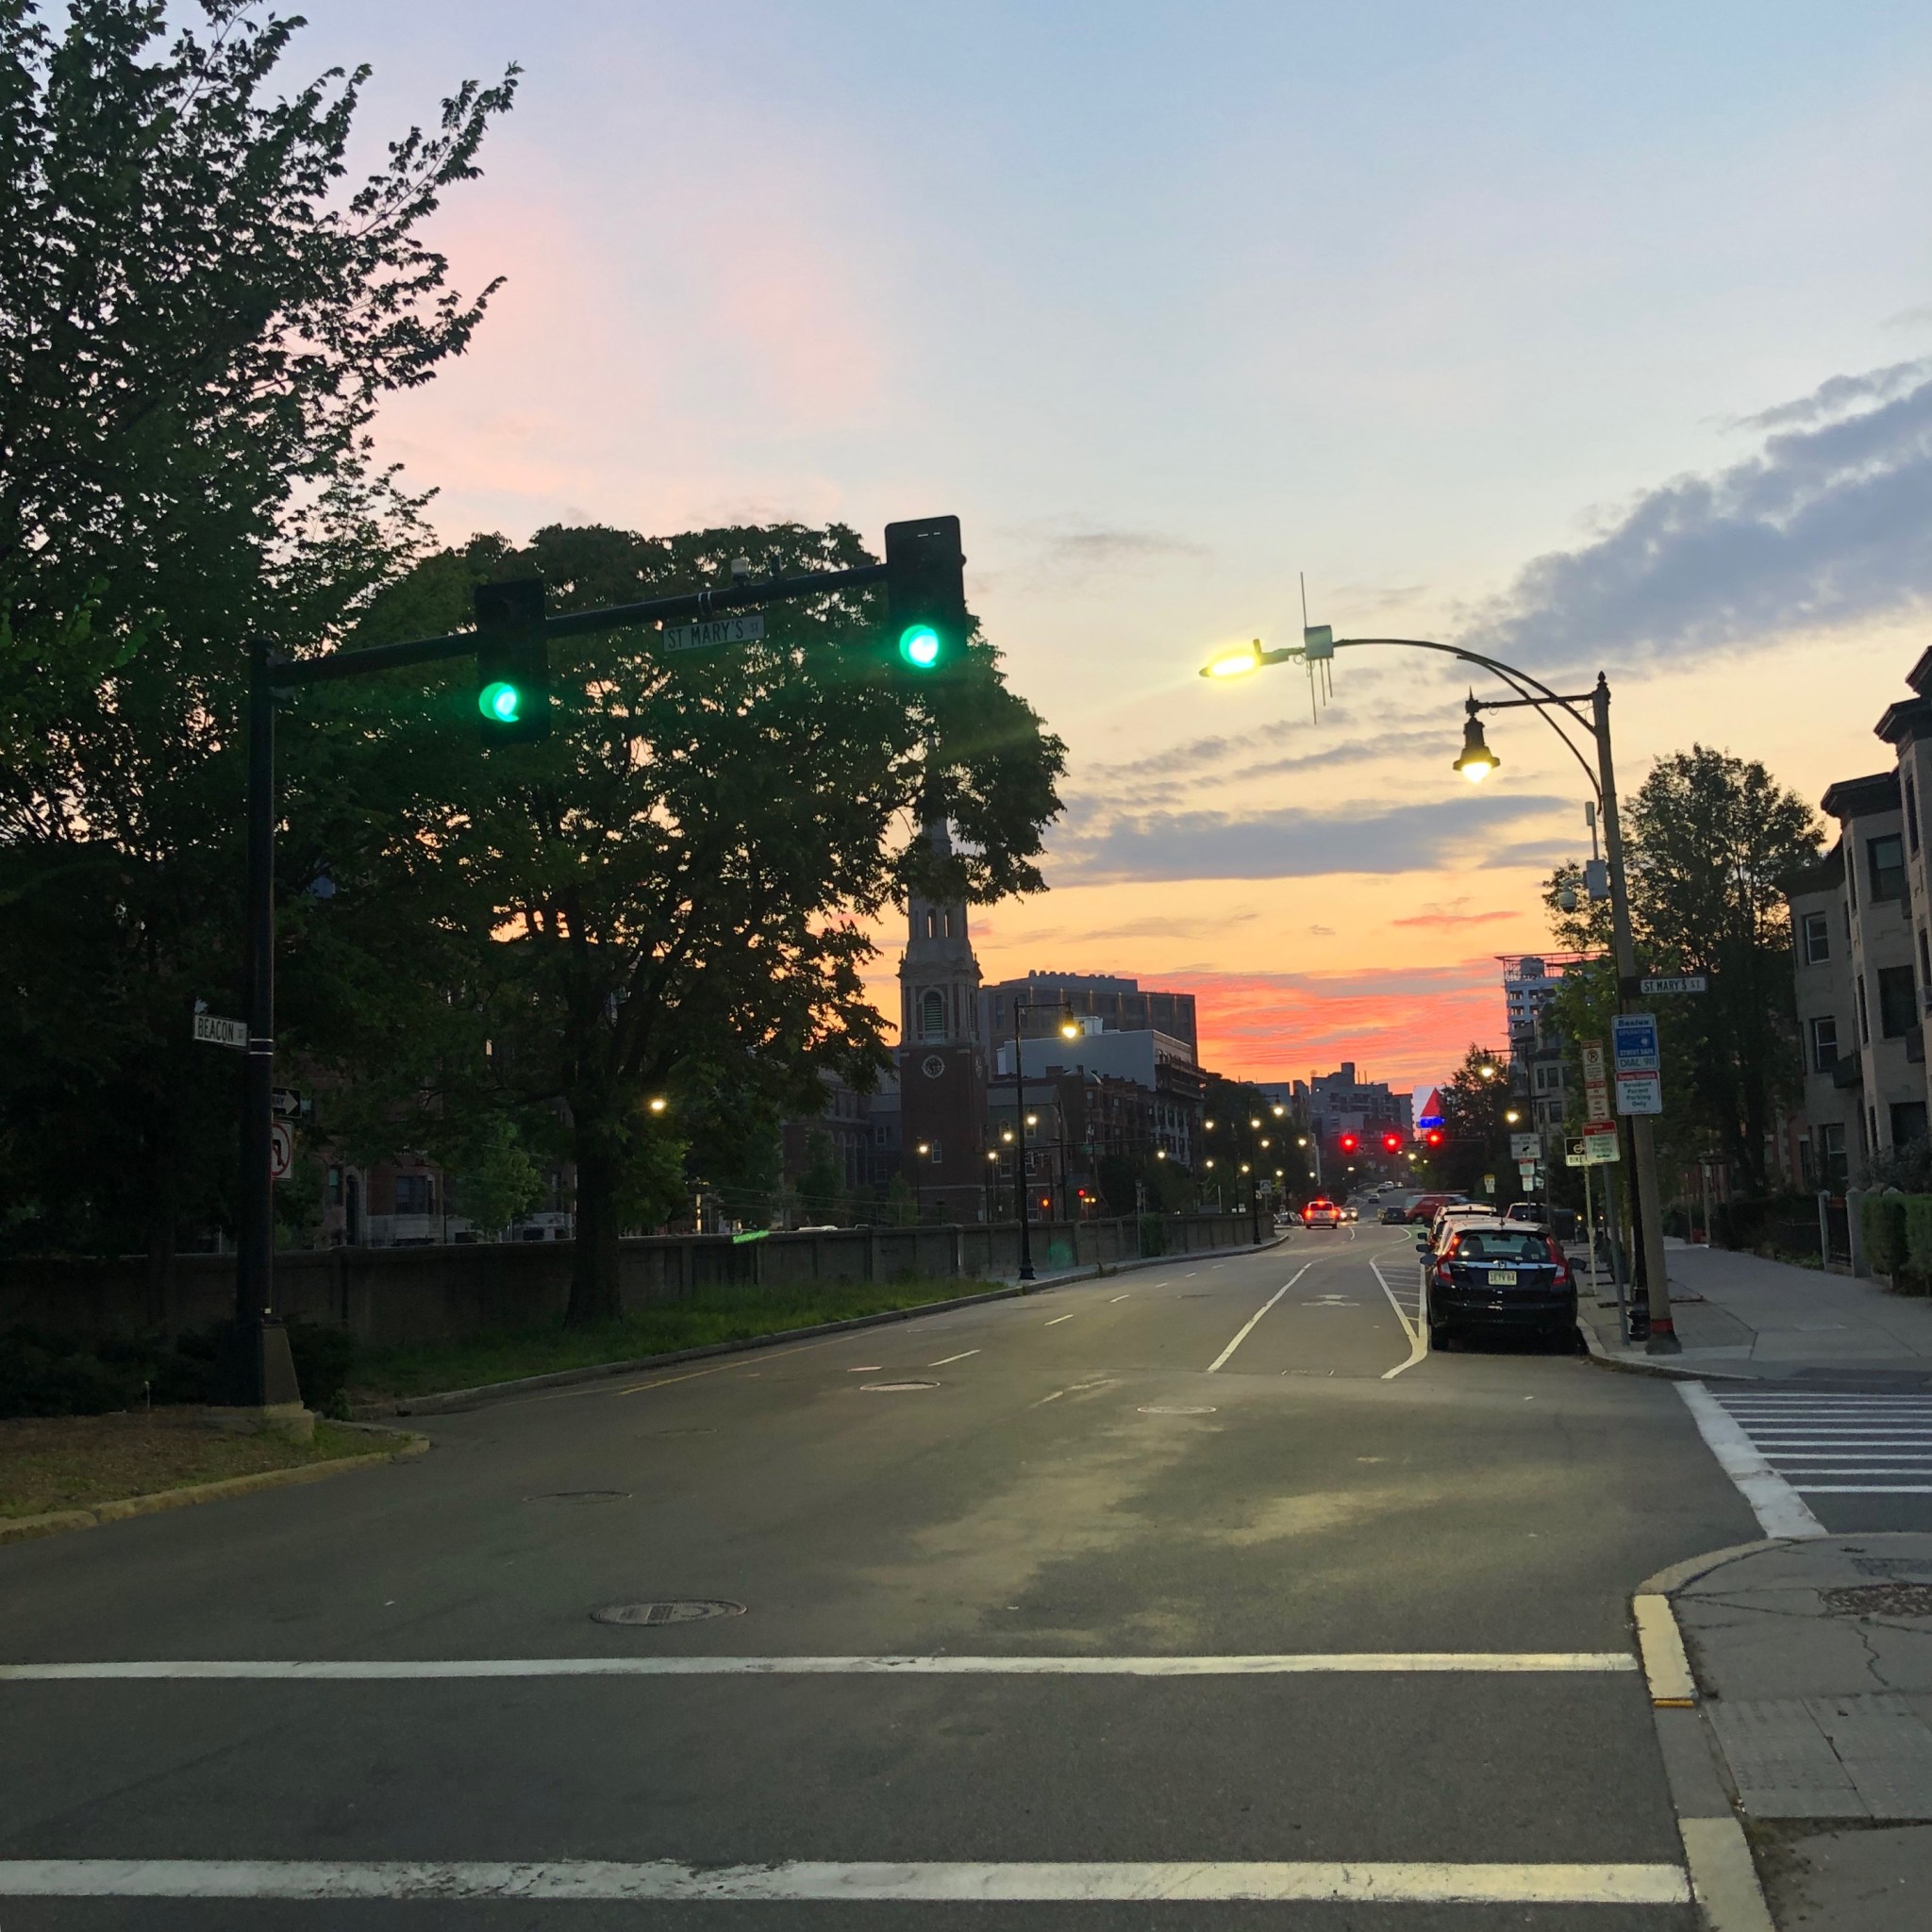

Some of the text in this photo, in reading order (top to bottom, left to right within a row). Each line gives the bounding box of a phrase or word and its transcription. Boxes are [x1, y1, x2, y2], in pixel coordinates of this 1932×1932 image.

[668, 629, 682, 649] ST
[691, 620, 743, 645] MARY'S
[1644, 981, 1653, 991] ST
[1690, 980, 1700, 989] ST
[198, 1017, 234, 1041] BEACON
[1620, 1057, 1655, 1067] DIAL 911
